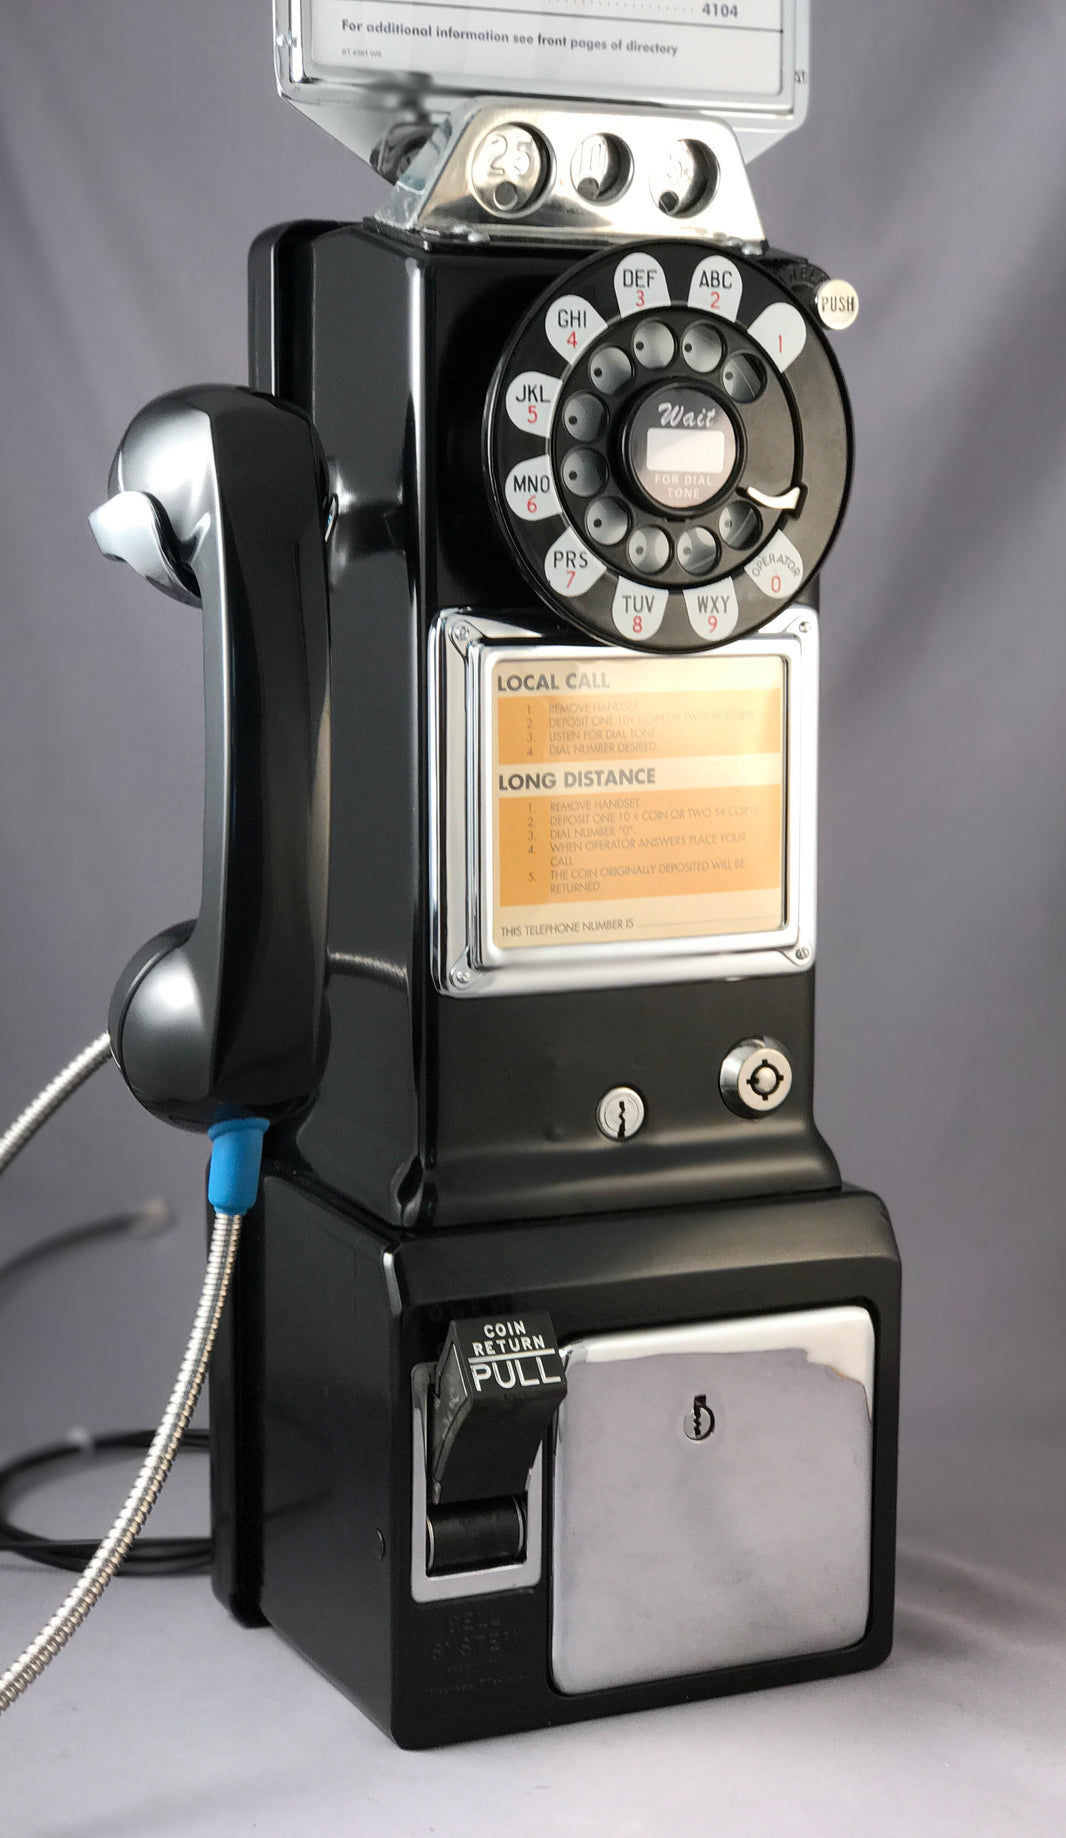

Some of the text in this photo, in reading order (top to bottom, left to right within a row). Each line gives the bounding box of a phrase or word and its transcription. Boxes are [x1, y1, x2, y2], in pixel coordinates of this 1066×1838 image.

[702, 3, 738, 18] 4104
[342, 19, 678, 57] For additional information see front pages of directory
[489, 134, 531, 177] 25
[623, 269, 657, 288] DEF
[699, 269, 733, 289] ABC
[635, 291, 646, 308] 3
[710, 293, 721, 309] 2
[821, 296, 855, 312] PUSH
[557, 309, 588, 328] GHI
[566, 331, 578, 349] 4
[777, 333, 783, 353] 1
[515, 384, 550, 402] JKL
[527, 406, 538, 424] 5
[658, 402, 716, 428] Wait
[513, 475, 551, 493] MNO
[655, 473, 713, 486] FOR DIAL
[668, 487, 700, 499] TONE
[526, 496, 538, 513] 6
[553, 551, 589, 568] PRS
[751, 553, 801, 578] OPERATOR
[565, 571, 577, 588] 7
[771, 574, 781, 593] 0
[622, 595, 656, 613] TUV
[697, 595, 731, 613] WXY
[632, 616, 643, 633] 8
[707, 616, 718, 632] 9
[497, 672, 610, 692] LOCAL CALL
[549, 702, 589, 715] REMOVE
[549, 716, 588, 729] DEPOSIT
[591, 714, 614, 727] ONE
[550, 730, 581, 743] LISTEN
[583, 729, 604, 741] FOR
[605, 728, 628, 740] DIAL
[550, 744, 571, 757] DIAL
[573, 742, 615, 755] NUMBER
[498, 767, 656, 791] LONG DISTANCE
[550, 799, 592, 813] REMOVE
[550, 813, 589, 827] DEPOSIT
[592, 811, 615, 825] ONE
[642, 808, 668, 821] COIN
[670, 808, 686, 820] OR
[688, 807, 712, 819] TWO
[550, 828, 572, 841] DIAL
[574, 825, 616, 839] NUMBER
[550, 840, 582, 854] WHEN
[585, 837, 636, 851] OPERATOR
[638, 834, 687, 849] ANSWERS
[689, 832, 717, 846] PLACE
[719, 831, 746, 843] YOUR
[549, 867, 568, 881] THE
[571, 865, 598, 879] COIN
[600, 861, 658, 878] ORIGINALLY
[659, 858, 710, 876] DEPOSITED
[711, 857, 733, 871] WILL
[735, 857, 745, 869] BE
[500, 917, 635, 938] THIS TELEPHONE NUMBER IS
[483, 1320, 527, 1339] COIN
[472, 1334, 546, 1357] RETURN
[470, 1355, 562, 1392] PULL
